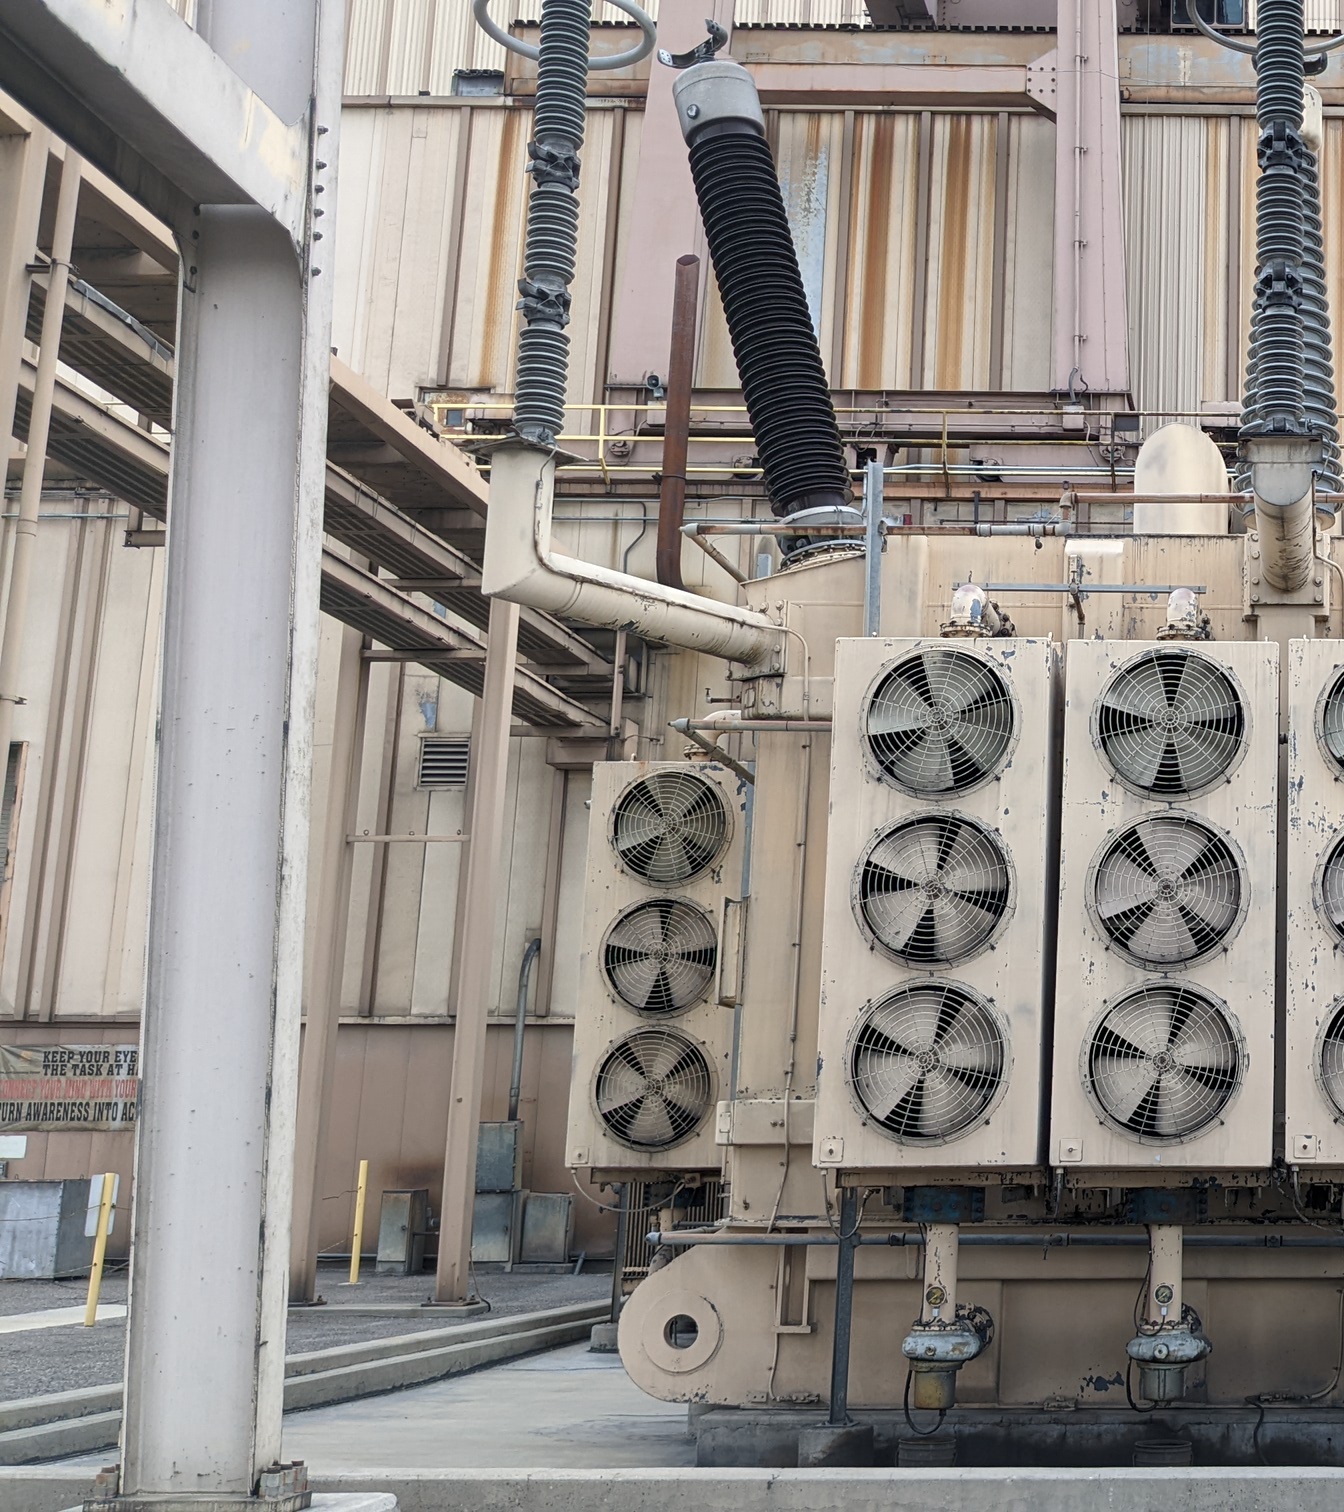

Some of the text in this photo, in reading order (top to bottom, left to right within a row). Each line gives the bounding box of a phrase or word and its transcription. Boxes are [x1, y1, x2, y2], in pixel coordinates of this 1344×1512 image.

[43, 1050, 139, 1063] KEEP YOUR EYE
[43, 1064, 67, 1076] THE
[72, 1064, 103, 1076] TASK
[107, 1064, 123, 1076] AT
[115, 1079, 136, 1098] YOUR
[25, 1102, 90, 1121] AWARENESS
[93, 1102, 118, 1121] INTO
